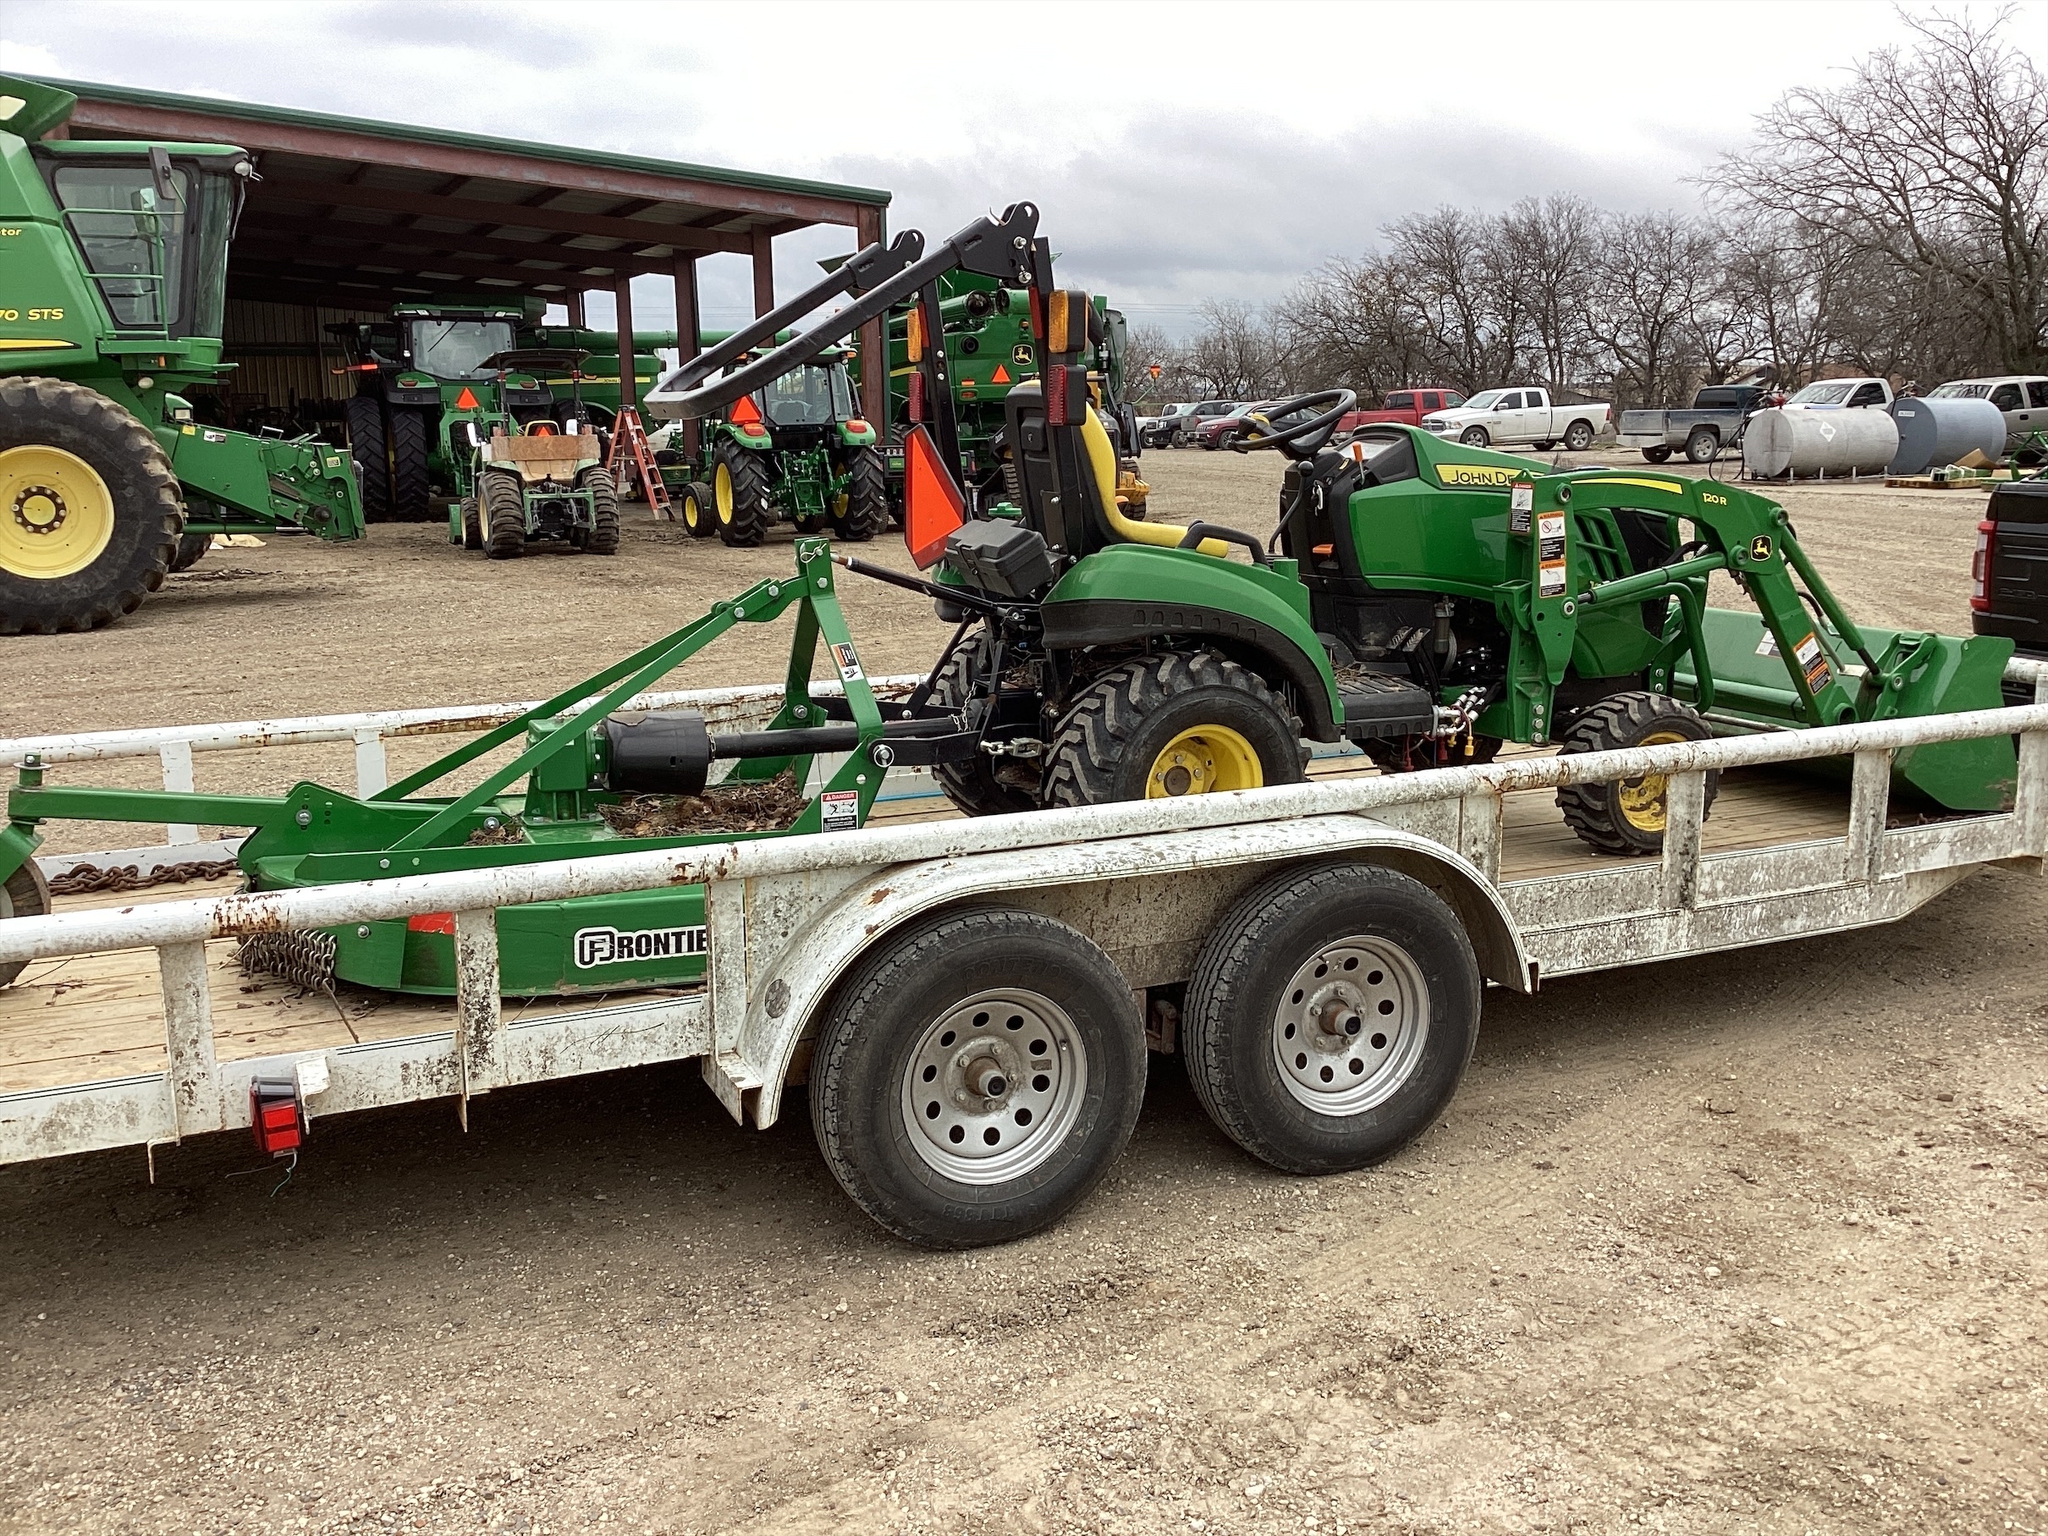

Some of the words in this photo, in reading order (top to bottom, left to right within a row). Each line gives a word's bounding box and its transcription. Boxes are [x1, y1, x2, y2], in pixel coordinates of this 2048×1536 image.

[0, 228, 22, 236] tor
[28, 308, 64, 321] STS
[1451, 470, 1492, 484] JOHN
